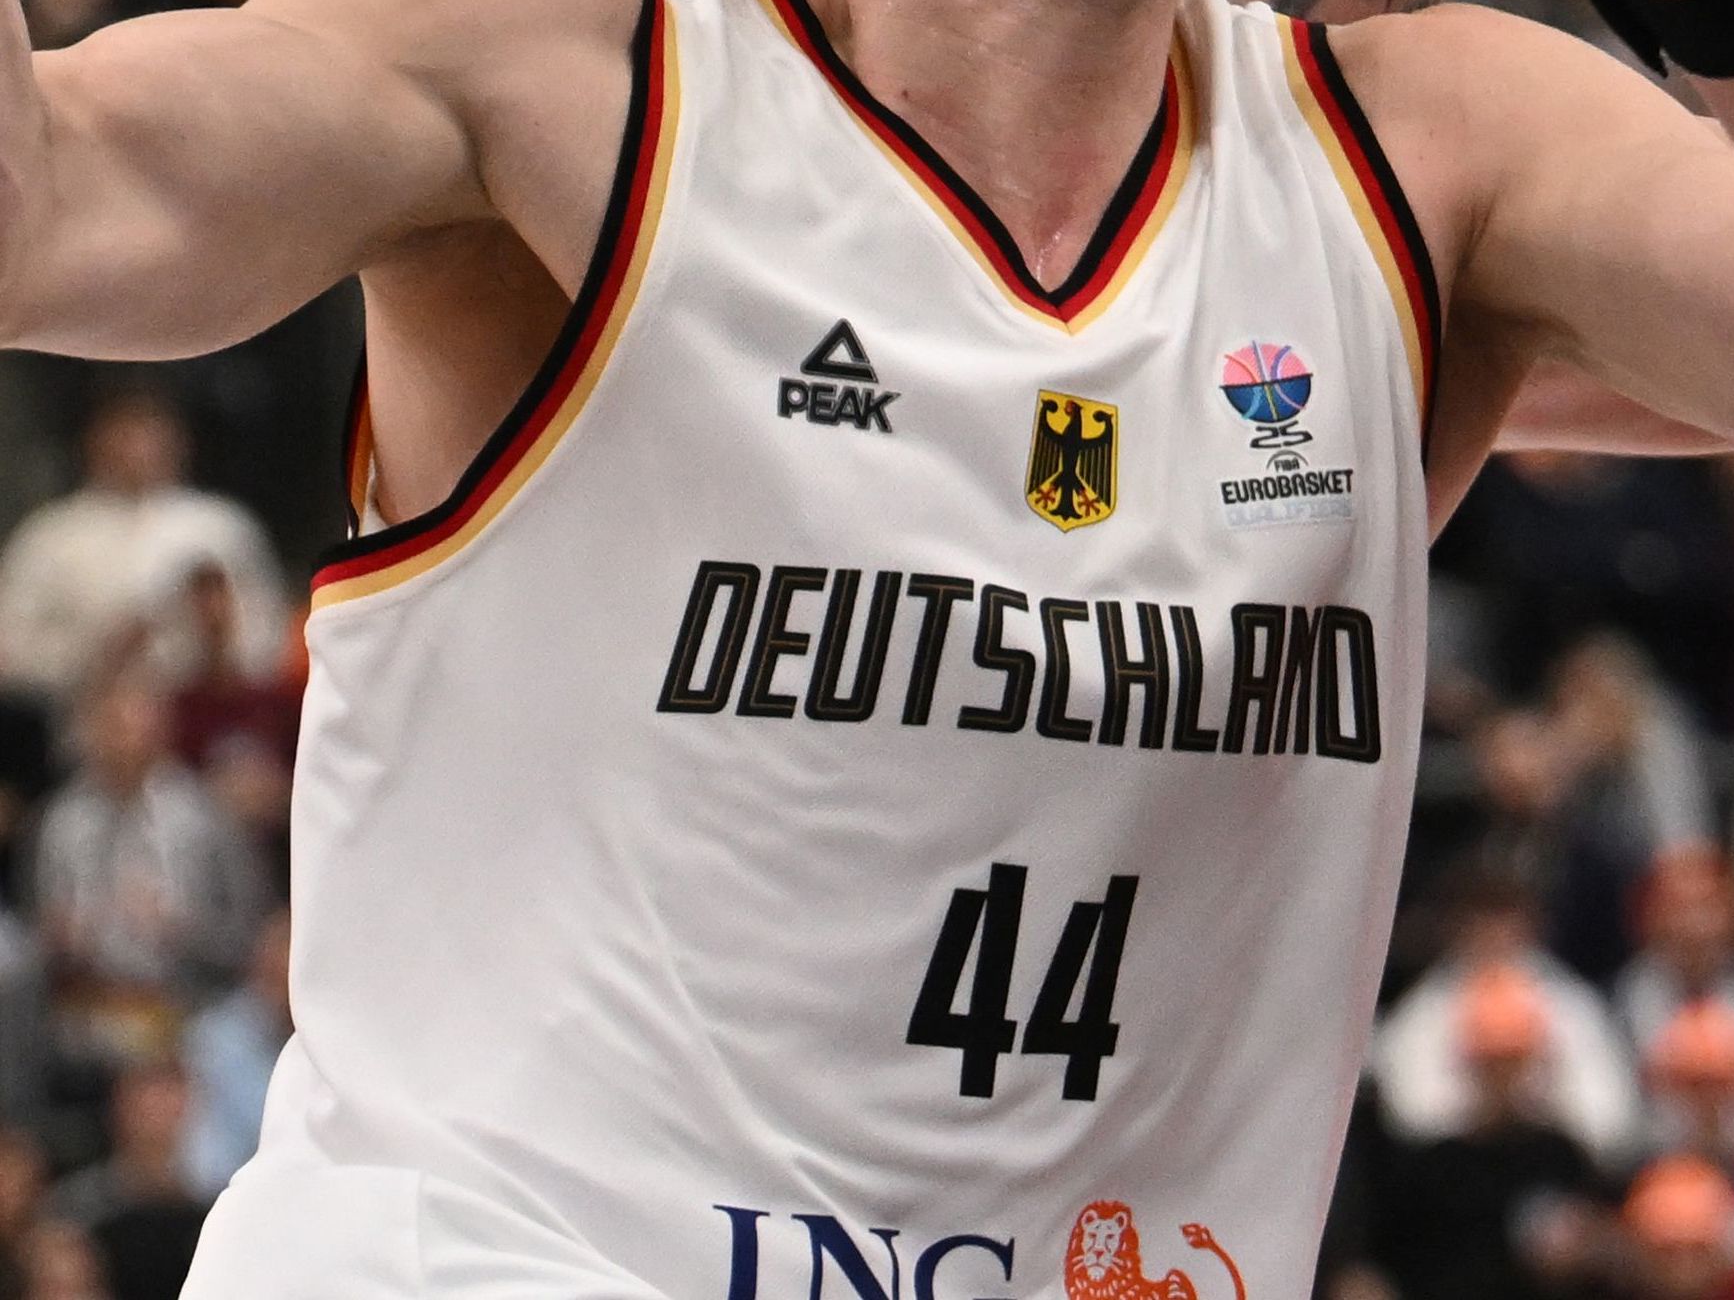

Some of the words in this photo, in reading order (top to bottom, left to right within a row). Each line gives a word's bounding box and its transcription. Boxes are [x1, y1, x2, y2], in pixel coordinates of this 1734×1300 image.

[777, 377, 901, 433] PEAK
[1250, 420, 1314, 449] 25
[1221, 468, 1354, 505] EUROBASKET
[1274, 456, 1300, 473] FIBA
[656, 560, 1382, 765] DEUTSCHLAND
[906, 862, 1140, 1102] 44
